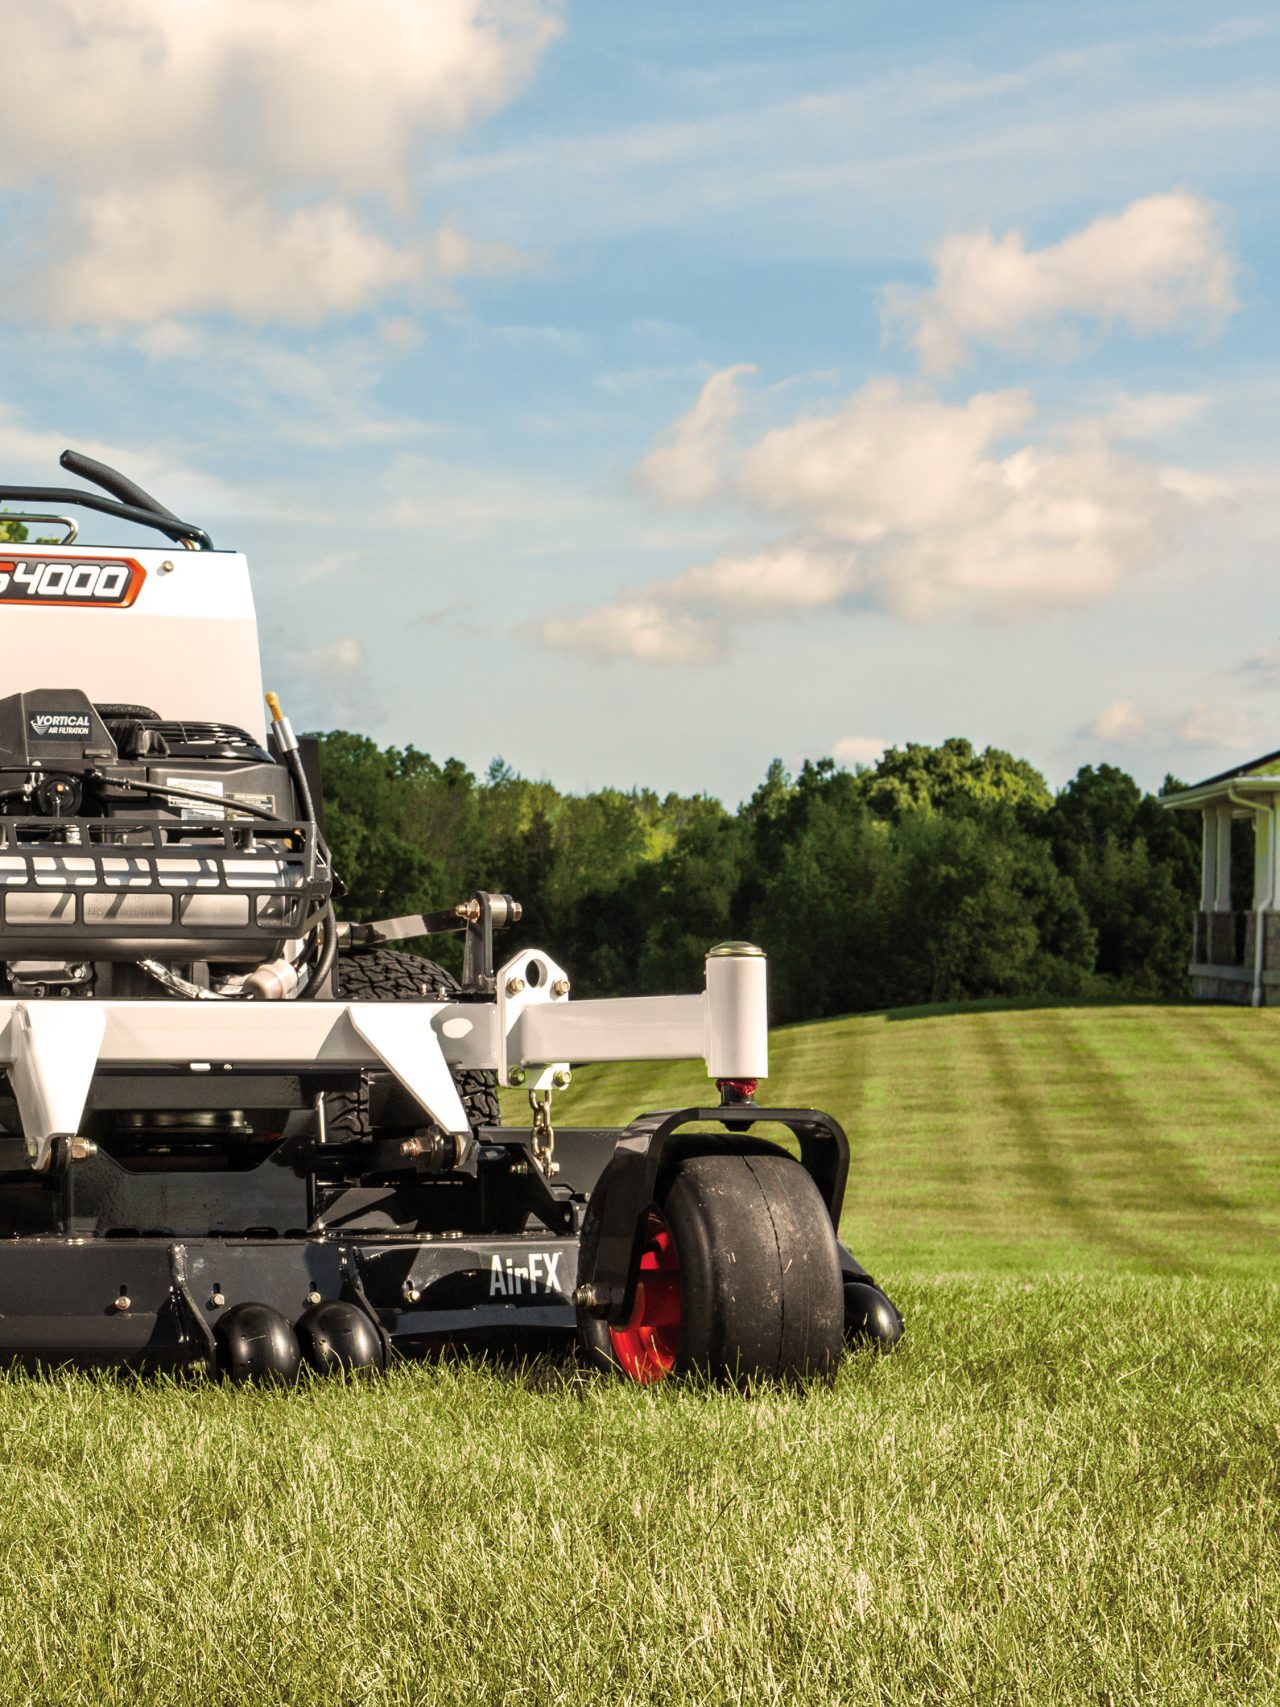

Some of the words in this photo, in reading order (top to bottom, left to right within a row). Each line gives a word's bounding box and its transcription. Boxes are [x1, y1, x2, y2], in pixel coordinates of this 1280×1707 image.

[36, 715, 90, 726] VORTICAL
[48, 726, 59, 734] AIR
[59, 727, 89, 735] FILTRATION
[489, 1252, 562, 1296] AirFX
